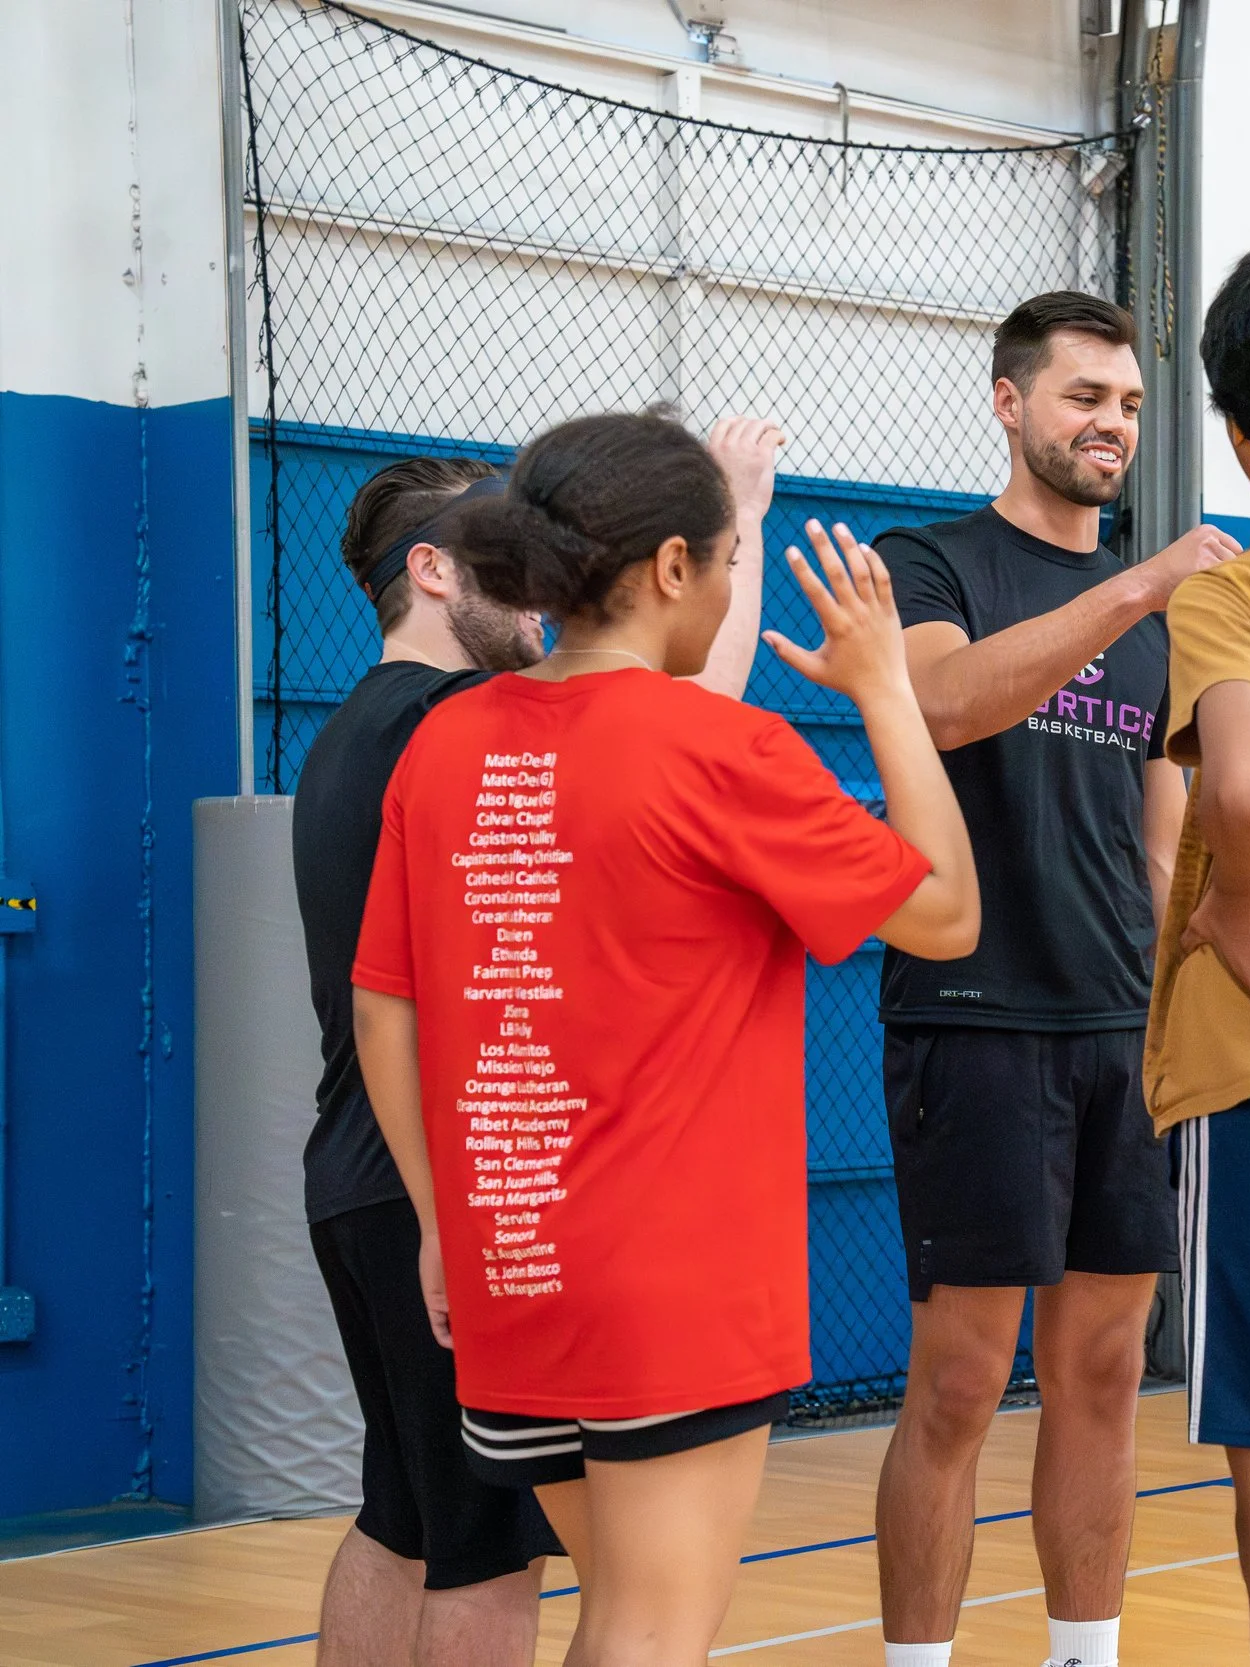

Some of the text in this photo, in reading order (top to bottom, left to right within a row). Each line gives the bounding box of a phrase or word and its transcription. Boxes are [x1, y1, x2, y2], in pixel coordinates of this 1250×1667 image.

[1027, 716, 1137, 751] BASKETBALL
[522, 965, 553, 981] Prep
[940, 990, 982, 998] DRI-FIT
[480, 1043, 505, 1058] Los
[465, 1079, 516, 1096] Orange
[529, 1097, 588, 1113] Academy
[470, 1117, 570, 1133] Ribet Academy
[465, 1135, 513, 1154] Rolling
[516, 1136, 541, 1151] Hills
[474, 1157, 501, 1171] San
[476, 1170, 559, 1190] San Juan Hills
[468, 1193, 504, 1207] Santa
[494, 1211, 541, 1227] Servite
[527, 1263, 561, 1278] Bosco
